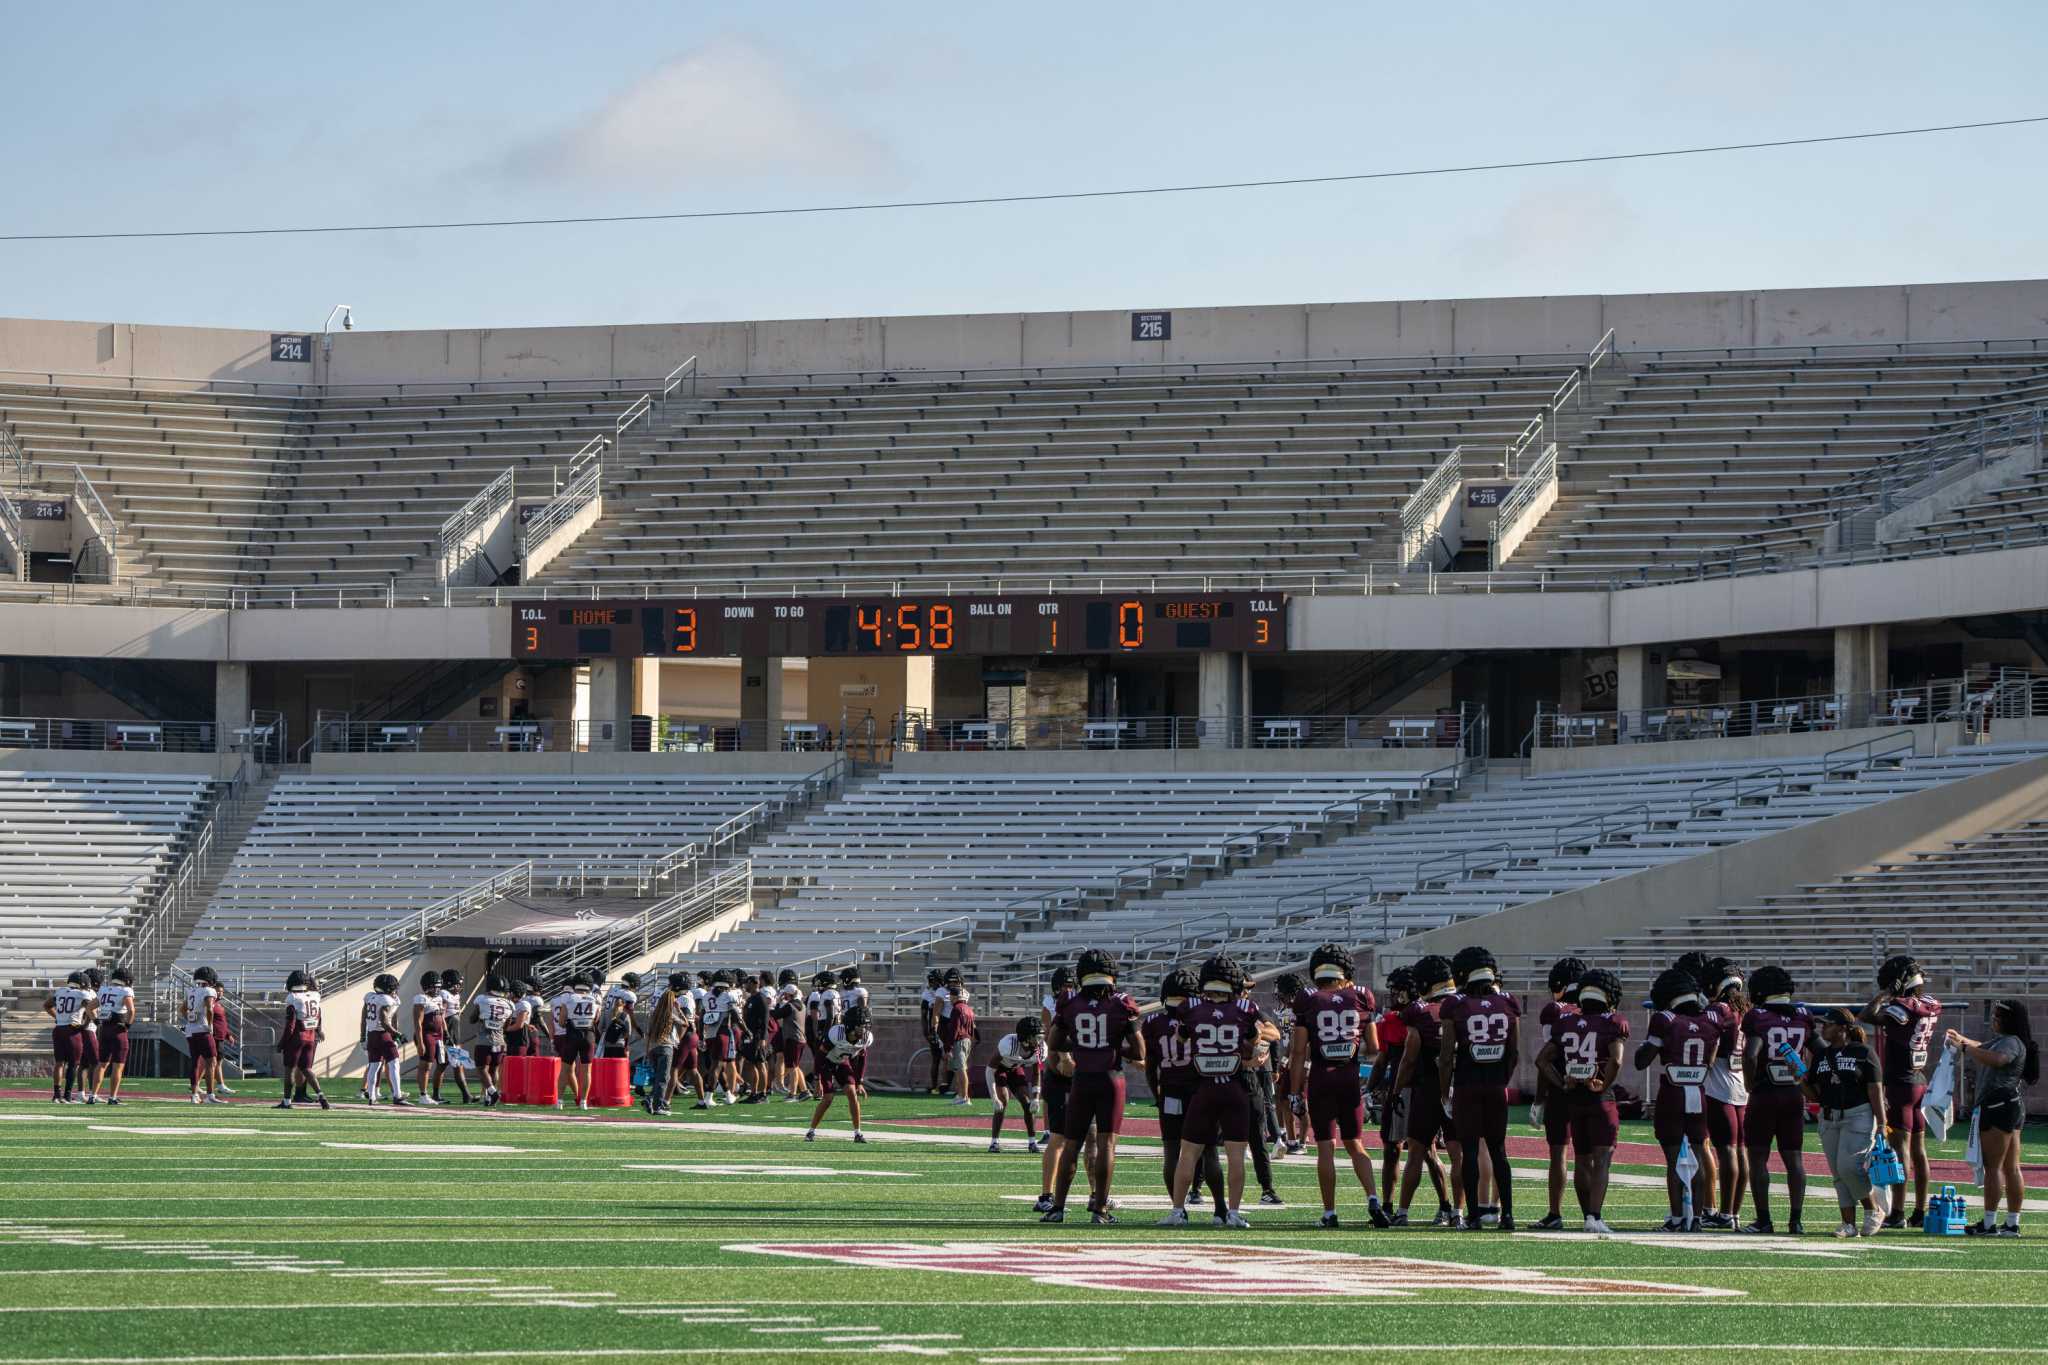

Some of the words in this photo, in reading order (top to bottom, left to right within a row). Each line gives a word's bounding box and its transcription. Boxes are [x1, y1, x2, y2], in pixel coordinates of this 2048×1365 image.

[1139, 322, 1162, 337] 215
[279, 343, 303, 359] 214
[1480, 493, 1497, 504] 215
[37, 506, 53, 517] 214
[520, 609, 546, 620] T.O.L.
[724, 606, 754, 618] DOWN
[774, 606, 787, 618] TO
[790, 606, 804, 617] GO
[970, 603, 995, 616] BALL
[997, 603, 1012, 615] ON
[1038, 603, 1059, 615] QTR
[1165, 602, 1221, 619] GUEST
[1249, 600, 1278, 612] T.O.L.
[572, 608, 616, 625] HOME
[1119, 601, 1144, 648] 0
[675, 607, 697, 652] 3
[857, 603, 953, 650] 4:58
[1052, 619, 1057, 648] 1
[1255, 618, 1269, 644] 3
[526, 626, 538, 651] 3
[57, 996, 76, 1015] 30
[304, 1000, 317, 1018] 16
[573, 1002, 593, 1016] 44
[1075, 1012, 1110, 1048] 81
[1316, 1010, 1360, 1041] 88
[1466, 1012, 1509, 1043] 83
[1195, 1023, 1240, 1053] 29
[1767, 1026, 1806, 1060] 87
[1159, 1034, 1191, 1068] 10
[1560, 1032, 1598, 1064] 24
[1682, 1038, 1705, 1065] 0
